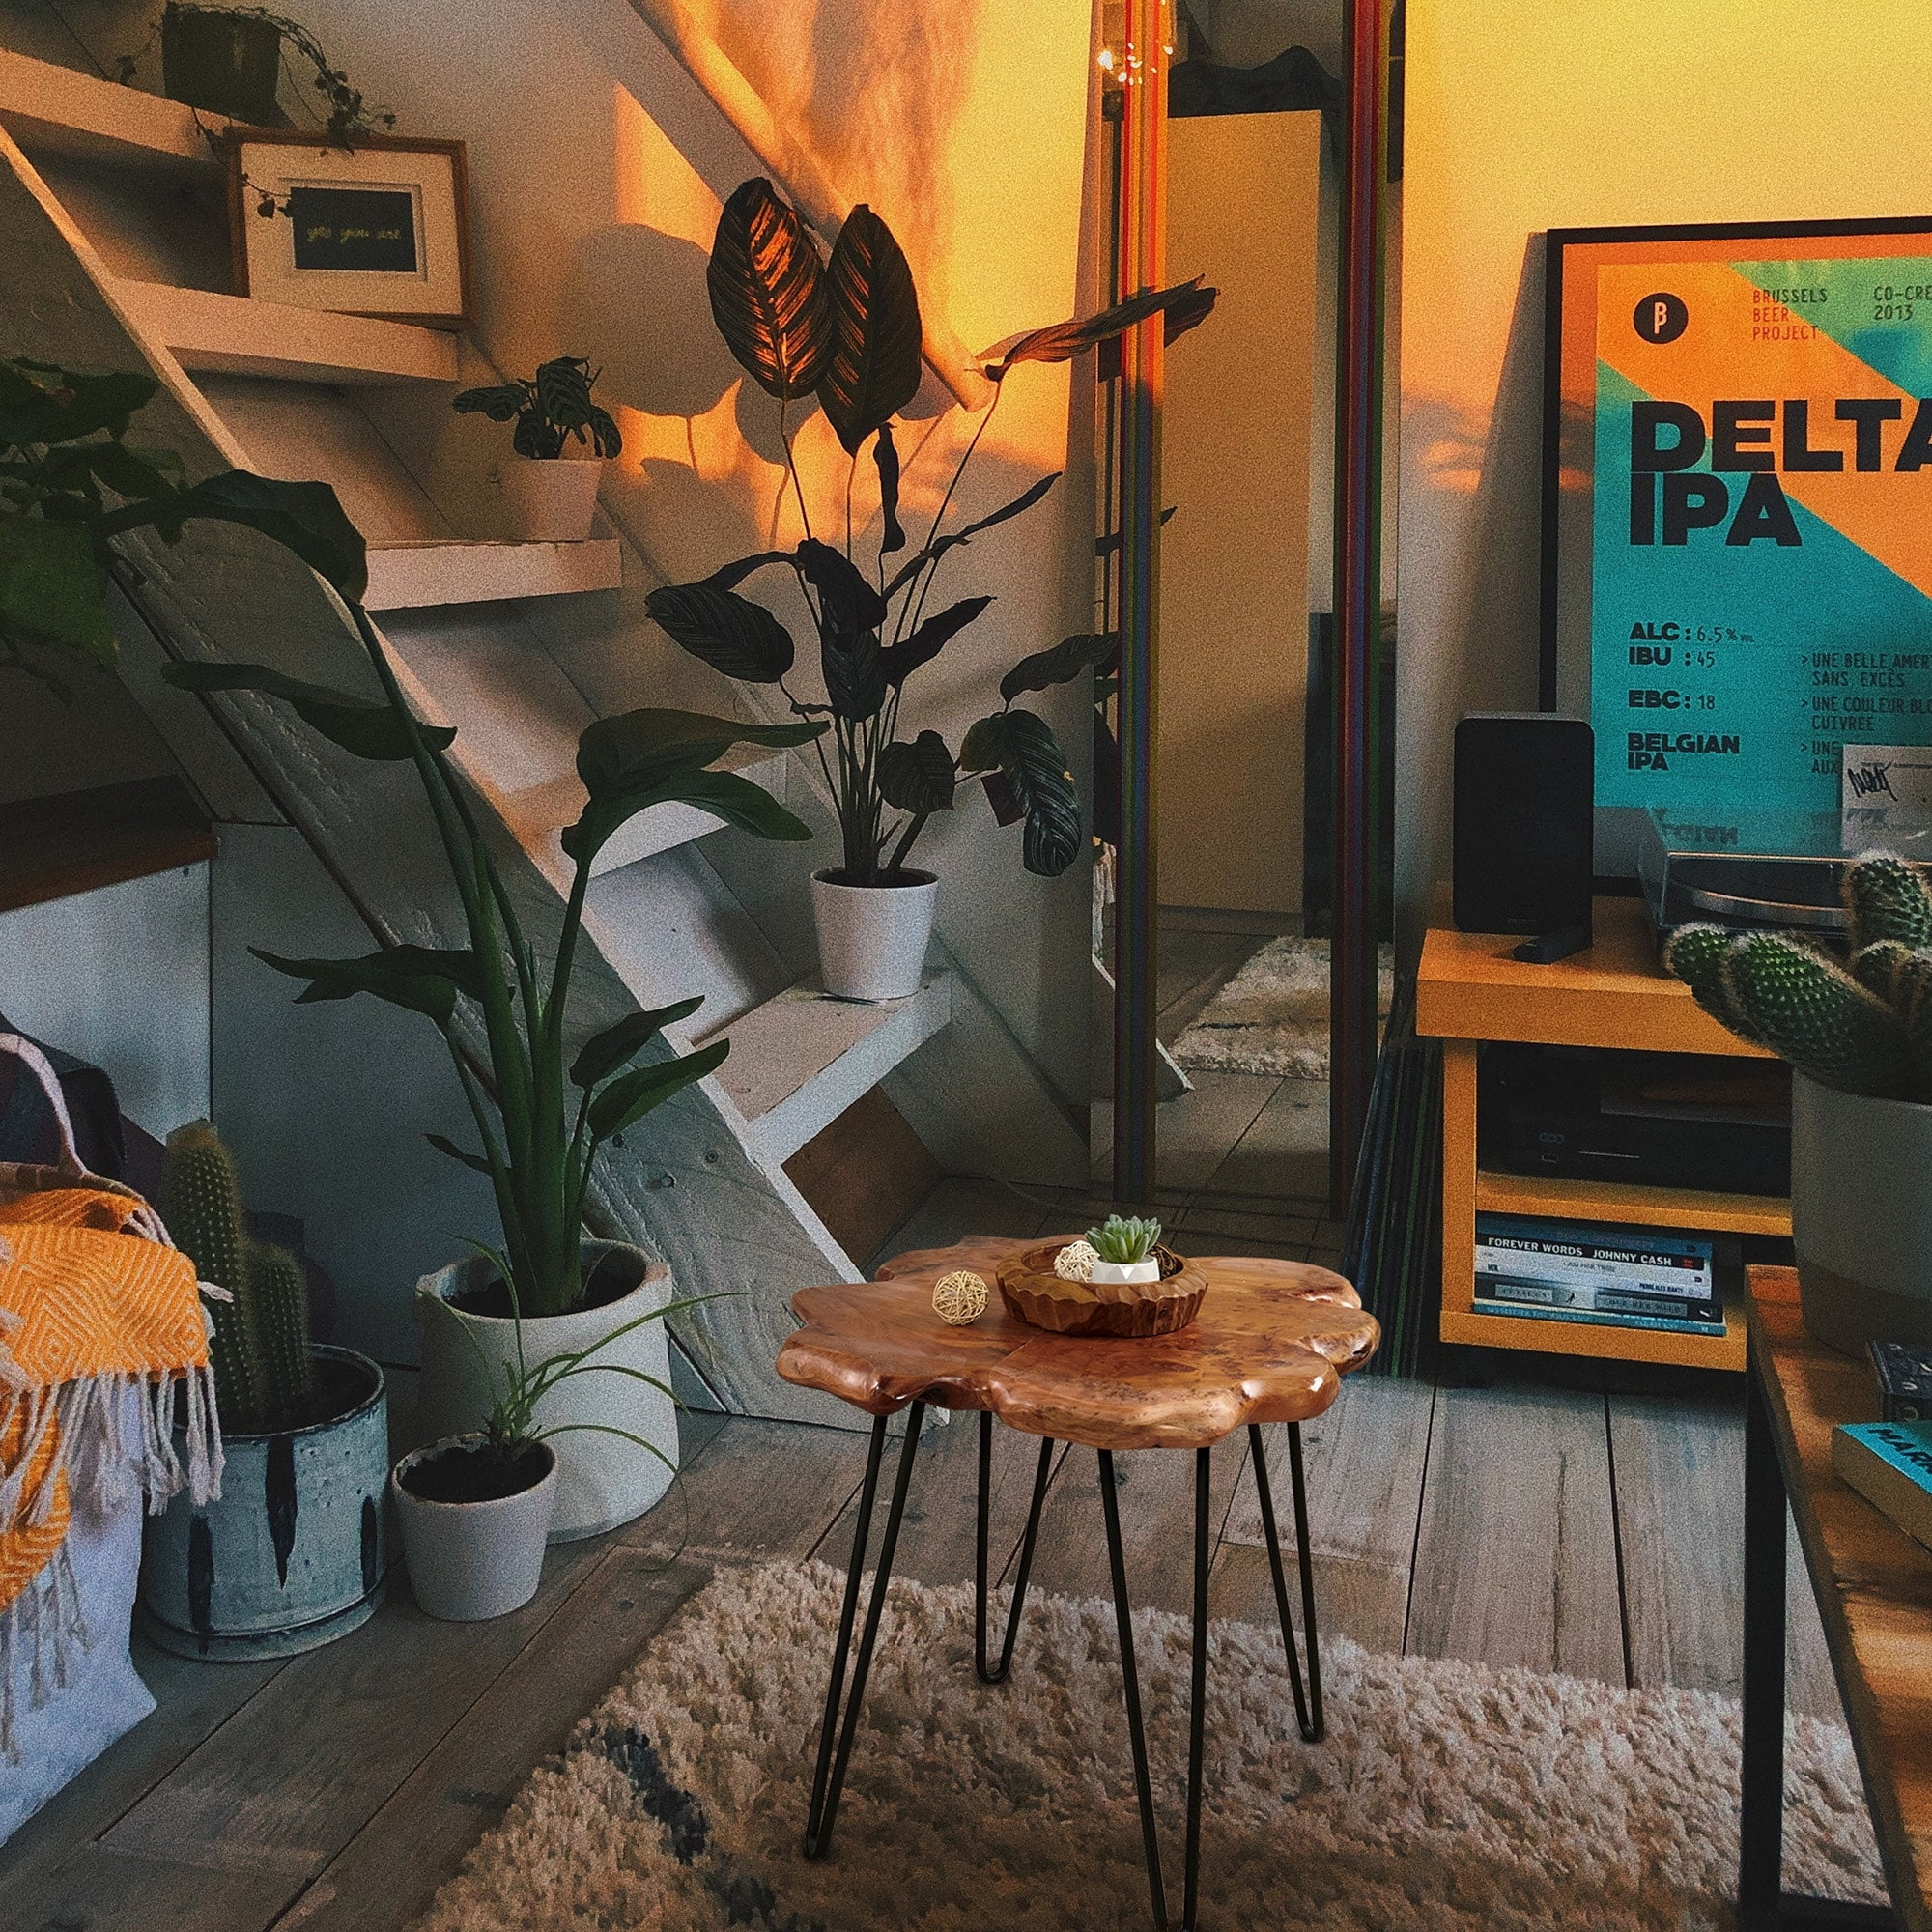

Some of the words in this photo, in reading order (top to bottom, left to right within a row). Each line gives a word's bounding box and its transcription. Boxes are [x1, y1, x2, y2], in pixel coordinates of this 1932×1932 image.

[1752, 288, 1828, 304] BRUSSELS
[1752, 307, 1789, 323] BEER
[1874, 304, 1913, 322] 2013
[1752, 325, 1818, 341] PROJECT
[1629, 472, 1803, 547] IPA
[1696, 650, 1716, 668] 45
[1812, 652, 1839, 668] UNE
[1843, 652, 1889, 668] BELLE
[1812, 670, 1850, 687] SANS
[1696, 694, 1716, 710] 18
[1812, 696, 1839, 712] UNE
[1842, 696, 1905, 714] COULEUR
[1627, 732, 1741, 754] BELGIAN
[1811, 741, 1840, 756] UNE
[1626, 752, 1670, 772] IPA
[1488, 1236, 1540, 1253] FOREVER
[1542, 1242, 1584, 1258] WORDS
[1593, 1248, 1637, 1264] JOHNNY
[1640, 1254, 1673, 1267] CASH
